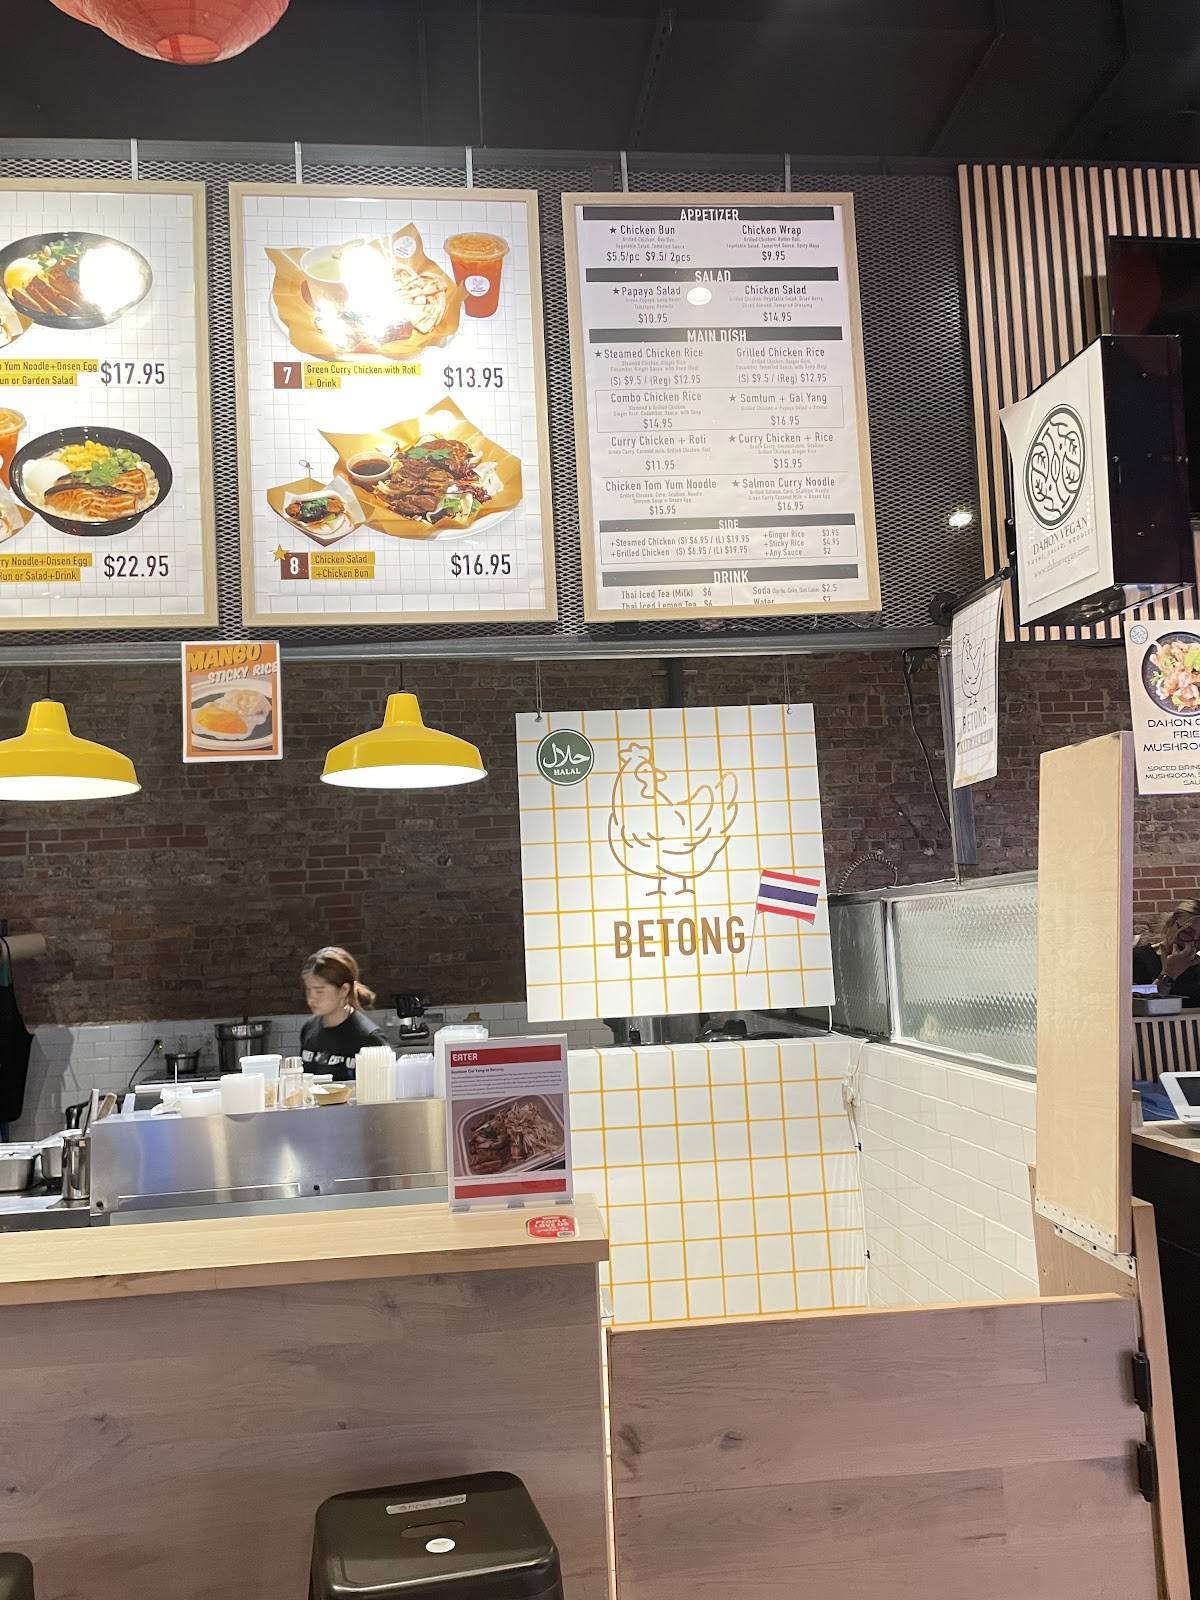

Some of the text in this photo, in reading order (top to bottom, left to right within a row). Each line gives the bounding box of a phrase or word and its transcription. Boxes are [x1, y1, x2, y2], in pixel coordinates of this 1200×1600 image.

[680, 209, 740, 221] APPETIZER
[620, 225, 676, 235] Chicken Bun
[742, 225, 802, 236] Chicken Wrap
[670, 252, 691, 264] 2pcs
[762, 251, 786, 261] $9.95
[694, 270, 731, 282] SALAD
[622, 286, 681, 298] Papaya Salad
[745, 284, 806, 294] Chicken Salad
[638, 312, 668, 324] $10.95
[763, 312, 792, 322] $14.95
[687, 330, 746, 342] MAIN DISH
[604, 348, 703, 358] Steamed Chicken Rice
[736, 347, 824, 357] Grilled Chicken Rice
[4, 362, 20, 370] Yum
[83, 362, 98, 372] Egg
[306, 365, 416, 376] Green Curry Chicken with Roti
[100, 360, 165, 387] $17.95
[283, 366, 292, 384] 7
[444, 365, 504, 390] $13.95
[738, 374, 748, 384] (S)
[778, 373, 798, 384] (Reg)
[800, 372, 827, 382] $12.95
[22, 376, 50, 384] Garden
[52, 375, 74, 384] Salad
[316, 378, 336, 388] Drink
[610, 376, 620, 386] (S)
[650, 376, 671, 386] (Reg)
[674, 374, 700, 384] $12.95
[610, 392, 702, 403] Combo Chicken Rice
[740, 393, 776, 402] Somtum
[790, 392, 804, 402] Gai
[806, 392, 827, 404] Yang
[643, 418, 673, 430] $14.95
[770, 415, 800, 426] $16.95
[612, 436, 636, 448] Curry
[640, 435, 674, 446] Chicken
[689, 434, 706, 444] Roti
[739, 434, 762, 444] Curry
[766, 432, 800, 443] Chicken
[814, 432, 833, 442] Rice
[645, 460, 675, 471] $11.95
[774, 458, 802, 469] $15.95
[606, 478, 716, 491] Chicken Tom Yum Noodle
[742, 476, 835, 489] Salmon Curry Noodle
[649, 505, 676, 516] $15.95
[778, 502, 804, 512] $16.95
[718, 520, 739, 530] SIDE
[648, 536, 676, 546] Chicken
[678, 536, 688, 546] (S)
[716, 536, 724, 544] (L)
[726, 535, 750, 544] $19.95
[1033, 532, 1058, 556] DAHON
[1060, 517, 1088, 538] VEGAN
[642, 548, 670, 557] Chicken
[676, 548, 686, 556] (S)
[714, 546, 722, 555] (L)
[724, 546, 748, 554] $19.95
[74, 556, 88, 567] Egg
[314, 554, 368, 564] Chicken Salad
[104, 554, 169, 580] $22.95
[290, 556, 298, 574] 8
[450, 552, 511, 578] $16.95
[354, 569, 369, 578] Bun
[714, 570, 749, 584] DRINK
[622, 588, 712, 600] Thai Iced Tea (Milk) $6
[752, 586, 771, 594] Soda
[822, 584, 837, 592] $2.5
[207, 661, 279, 684] STICKY RICE
[962, 706, 987, 734] BETONG
[1148, 719, 1192, 728] DAHON
[1174, 730, 1200, 738] FRIE
[1144, 742, 1200, 752] MUSHRO
[543, 742, 590, 768] حلال
[554, 768, 580, 776] HALAL
[613, 916, 746, 958] BETONG
[452, 1052, 478, 1062] EATER
